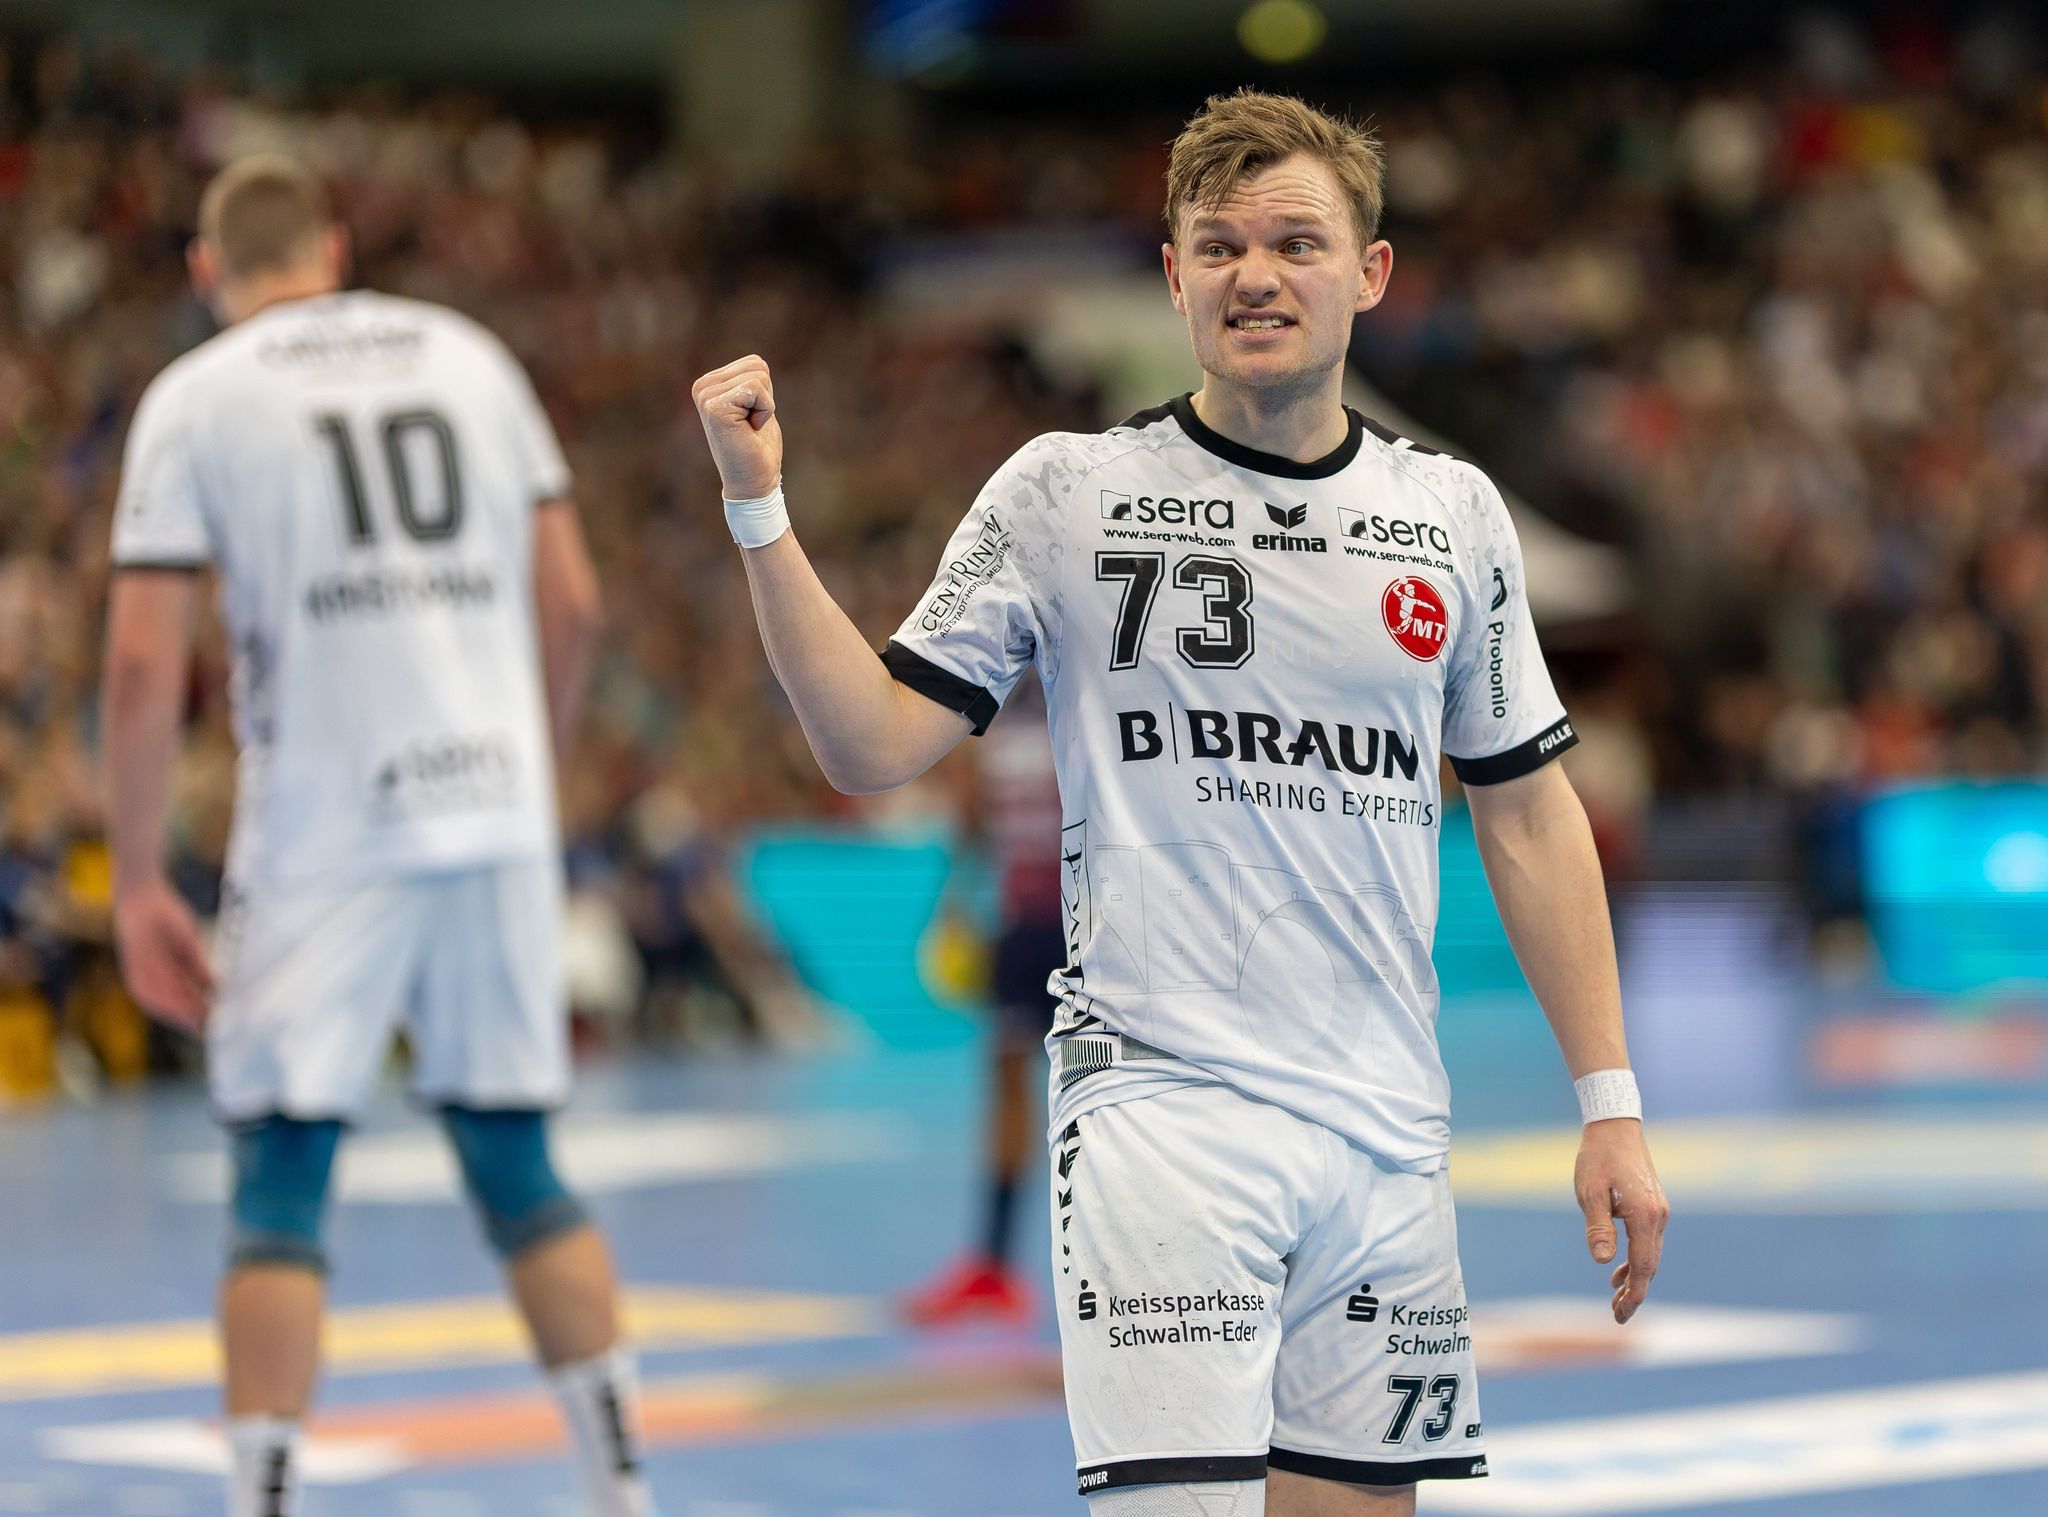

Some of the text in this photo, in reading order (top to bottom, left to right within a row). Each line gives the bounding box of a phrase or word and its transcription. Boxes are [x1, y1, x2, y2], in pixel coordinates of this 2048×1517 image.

[309, 408, 465, 545] 10
[1136, 496, 1235, 530] sera
[1103, 528, 1236, 548] www.sera-web.com
[1252, 532, 1328, 553] erima
[1370, 515, 1452, 555] sera
[1343, 545, 1454, 574] www.sera-web.com
[1095, 550, 1255, 672] 73
[1412, 617, 1446, 642] MT
[1488, 621, 1509, 719] Probonio
[1184, 708, 1420, 782] BRAUN
[1538, 723, 1573, 754] FULLE
[1195, 776, 1437, 828] SHARING EXPERTIS
[1109, 1289, 1265, 1318] Kreissparkasse
[1109, 1320, 1258, 1348] Schwalm-Eder
[1381, 1373, 1461, 1444] 73
